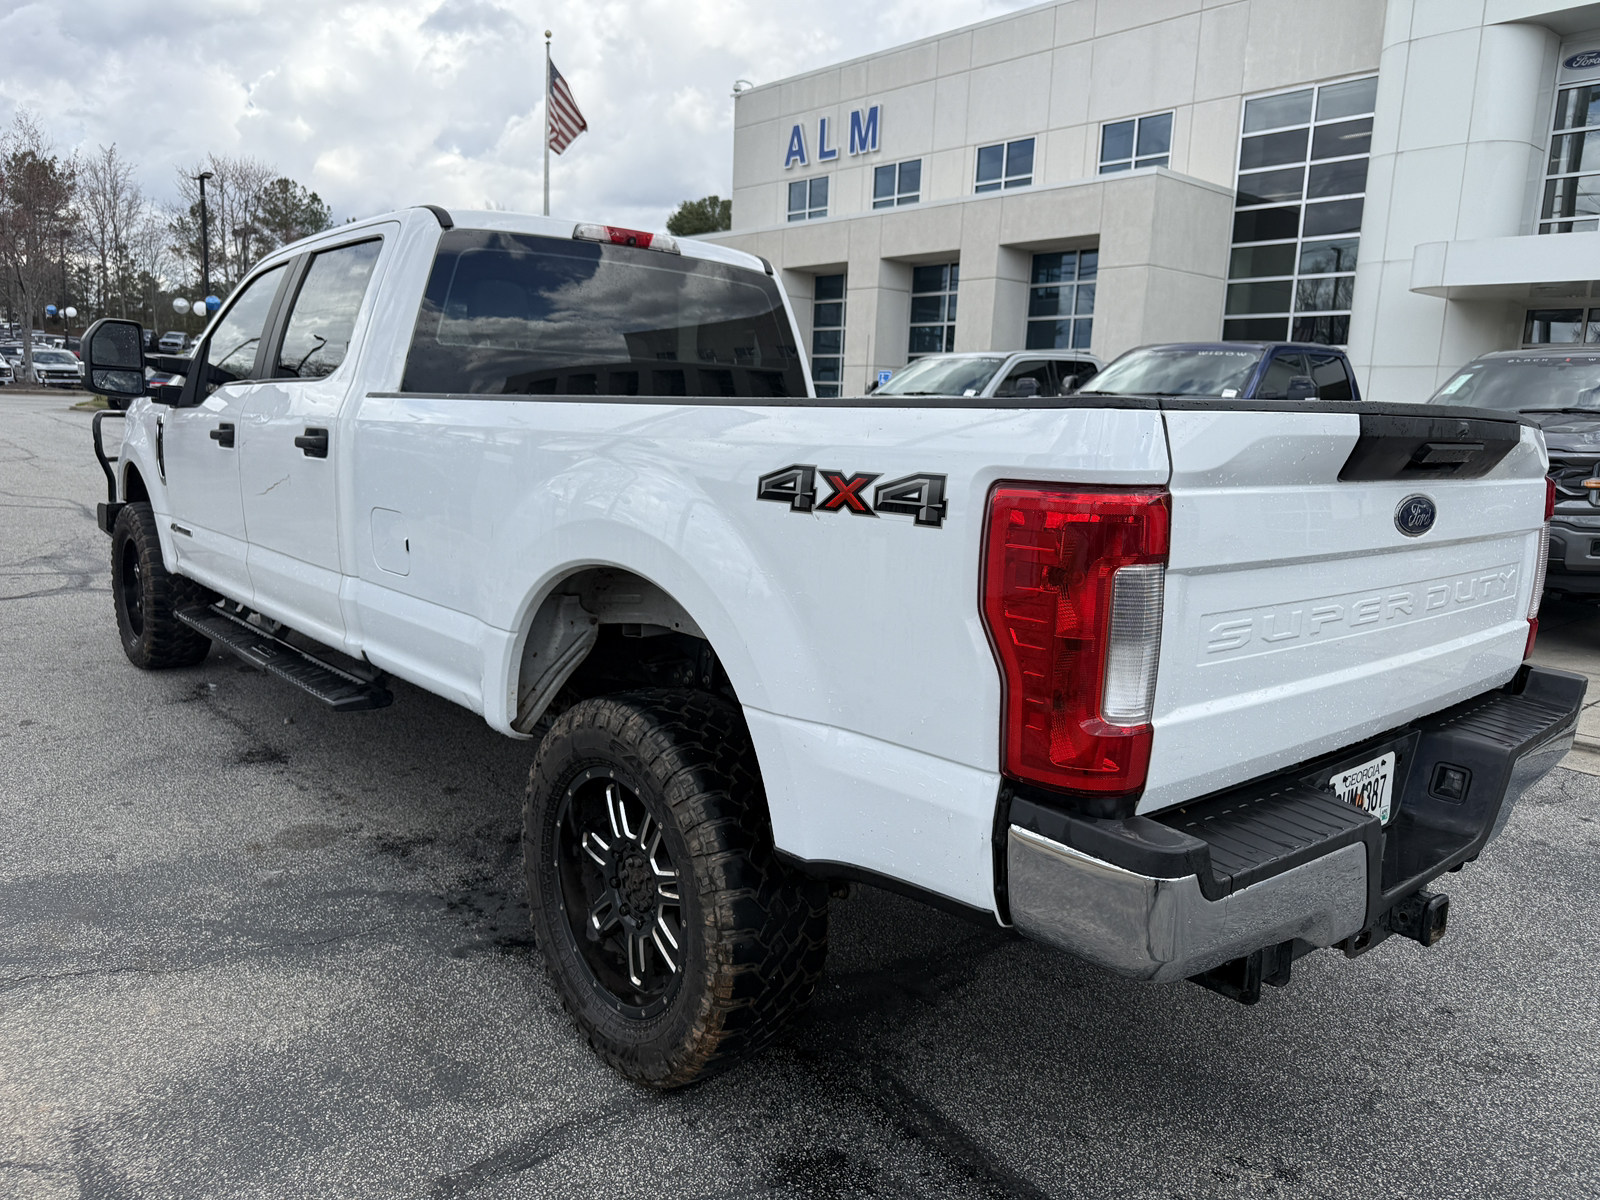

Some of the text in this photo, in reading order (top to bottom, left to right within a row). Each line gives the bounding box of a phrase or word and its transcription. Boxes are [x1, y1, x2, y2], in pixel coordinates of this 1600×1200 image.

[784, 105, 881, 169] ALM
[1207, 568, 1517, 654] SUPER DUTY
[1344, 763, 1381, 788] GEORGIA
